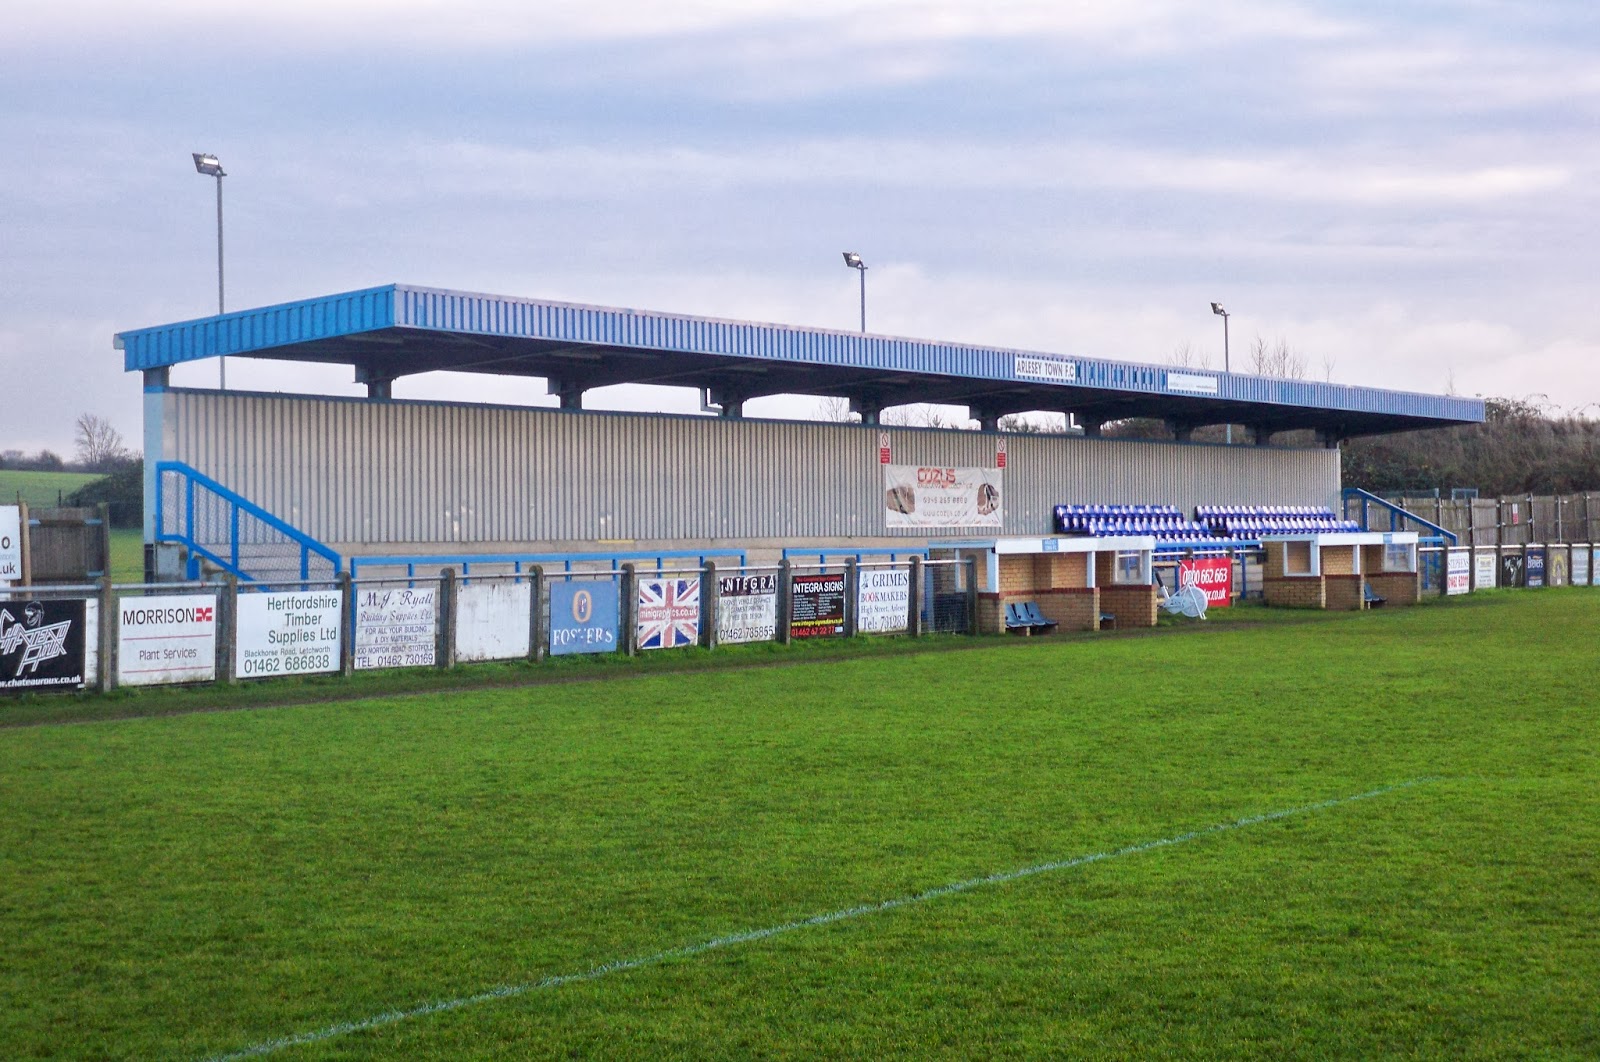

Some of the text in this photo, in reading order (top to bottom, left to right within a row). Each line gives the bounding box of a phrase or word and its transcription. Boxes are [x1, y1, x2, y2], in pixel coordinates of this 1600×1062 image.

[1017, 360, 1042, 374] ARLESEY
[1044, 363, 1063, 377] TOWN
[872, 572, 908, 588] GRIMES
[1200, 568, 1214, 584] 662
[1214, 567, 1228, 583] 663
[793, 580, 844, 594] INTEGRA SIGNS
[267, 595, 338, 611] Hertfordshire
[399, 590, 433, 609] Ryall
[860, 591, 907, 603] BOOKMAKERS
[123, 607, 195, 625] MORRISON
[860, 605, 873, 616] High
[285, 612, 323, 627] Timber
[861, 616, 878, 630] Tel:
[268, 626, 337, 646] Supplies Ltd
[365, 627, 376, 635] FOR
[377, 627, 387, 635] ALL
[389, 626, 402, 634] YOUR
[719, 628, 743, 640] 01462
[791, 627, 810, 637] 01462
[819, 625, 828, 635] 22
[139, 648, 197, 661] Plant Services
[244, 649, 279, 658] Blackhorse
[299, 645, 331, 655] Letchworth
[244, 654, 330, 674] 01462 686838
[377, 655, 402, 667] 01462
[405, 653, 433, 665] 730169
